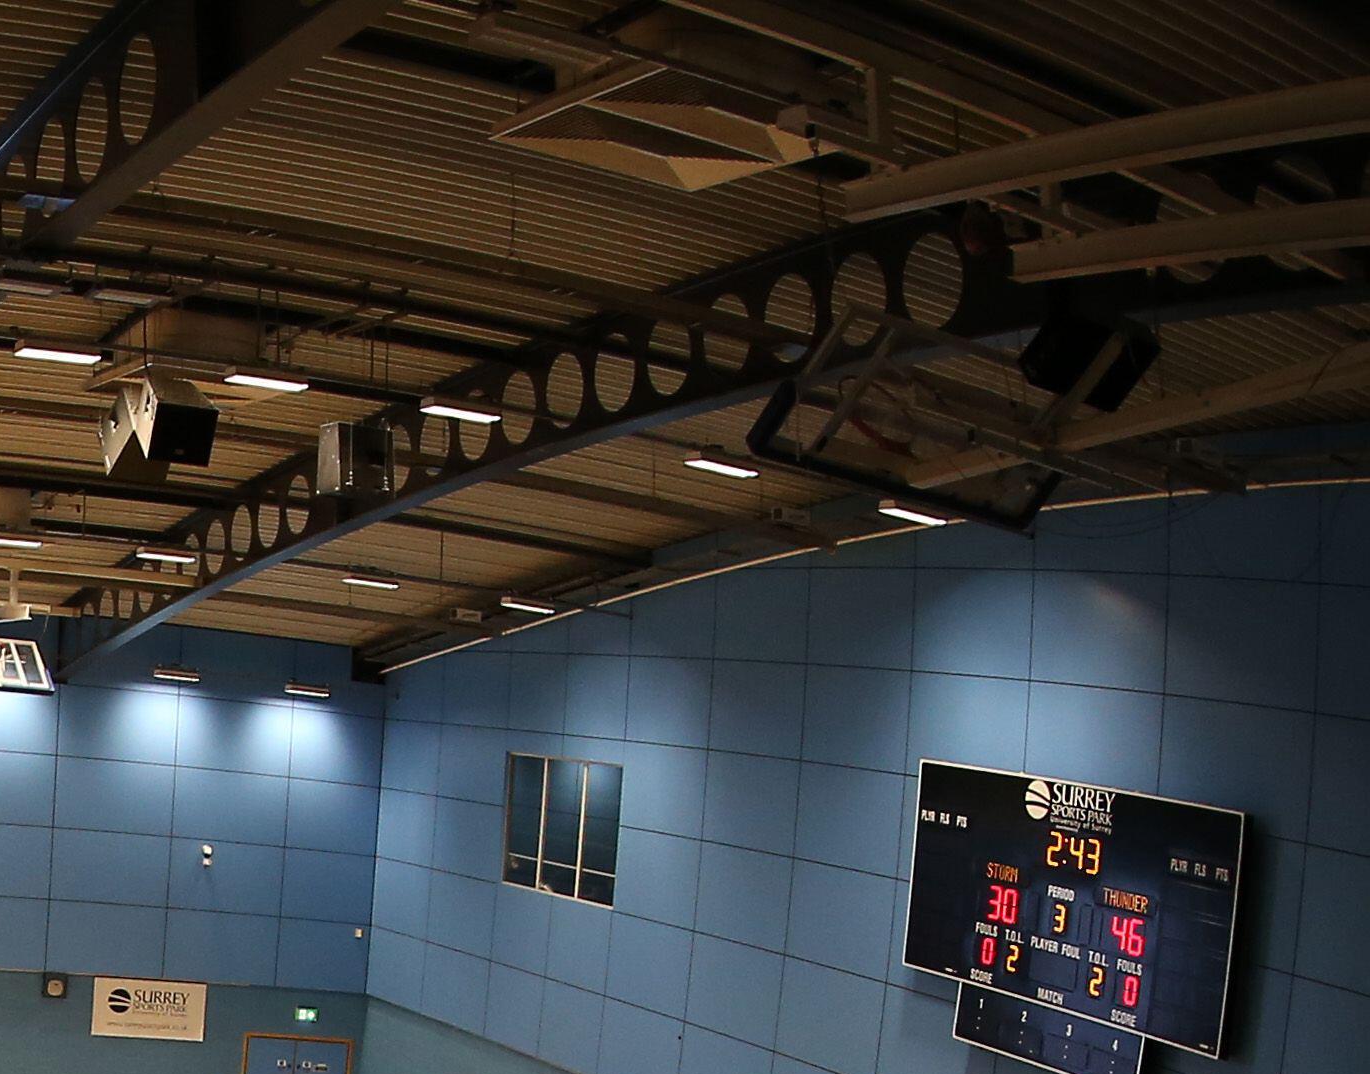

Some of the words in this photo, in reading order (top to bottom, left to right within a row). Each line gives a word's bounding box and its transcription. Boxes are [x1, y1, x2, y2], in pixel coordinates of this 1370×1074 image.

[1052, 783, 1116, 813] SURREY
[956, 815, 968, 829] PTS
[1051, 803, 1087, 821] SPORTS
[1088, 810, 1113, 827] PARK
[1046, 831, 1101, 875] 2:43
[986, 861, 1019, 884] STORM
[1170, 858, 1189, 874] PLYR
[1194, 863, 1206, 876] FLS
[1215, 868, 1229, 882] PTS
[987, 884, 1019, 925] 30
[1047, 884, 1075, 902] PERIOD
[1102, 886, 1149, 914] THUNDER
[1054, 903, 1067, 934] 3
[975, 921, 999, 938] FOULS
[1030, 935, 1059, 954] PLAYER
[1061, 943, 1081, 960] FOUL
[1117, 958, 1143, 976] FOULS
[1112, 915, 1146, 958] 46
[980, 937, 995, 967] 0
[1006, 944, 1019, 973] 2
[134, 989, 190, 1005] SURREY
[970, 967, 993, 984] SCORE
[1037, 987, 1064, 1005] MATCH
[1110, 1008, 1137, 1027] SCORE
[1088, 966, 1103, 997] 2
[1124, 975, 1140, 1007] 0
[133, 1002, 164, 1012] SPORTS
[1021, 1011, 1027, 1022] 2
[1066, 1024, 1072, 1037] 3
[1112, 1038, 1118, 1052] 4
